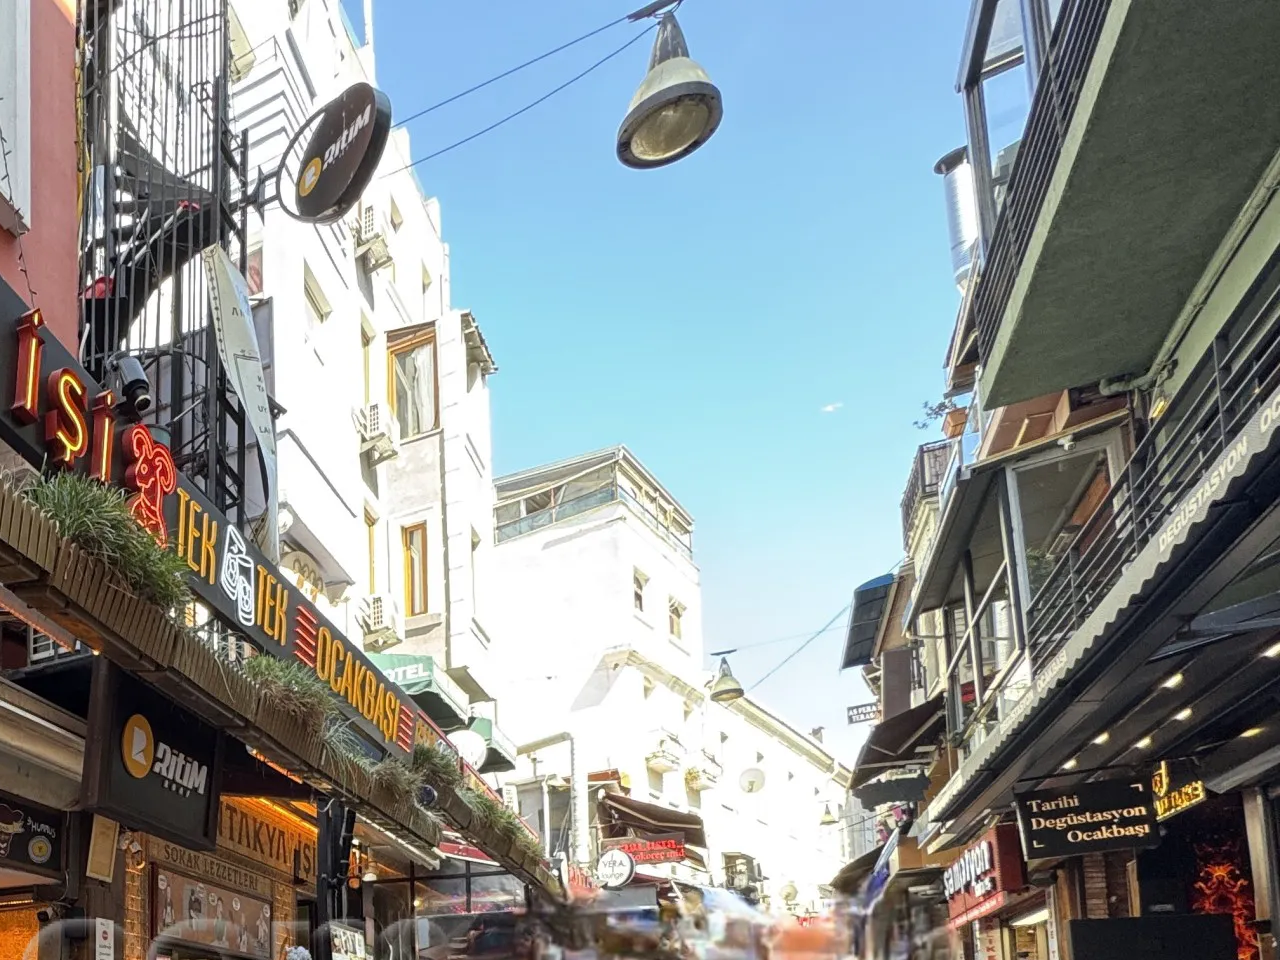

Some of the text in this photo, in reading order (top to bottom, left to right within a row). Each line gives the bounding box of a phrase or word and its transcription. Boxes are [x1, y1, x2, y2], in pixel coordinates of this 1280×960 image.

[176, 486, 400, 743] TEK TEK OCAKBAŞI
[1026, 794, 1080, 813] Tarihi
[1030, 806, 1147, 830] Degüstasyon
[217, 800, 288, 864] TAKYA
[1066, 823, 1151, 843] Ocakbaşı
[164, 843, 200, 869] SOKAK
